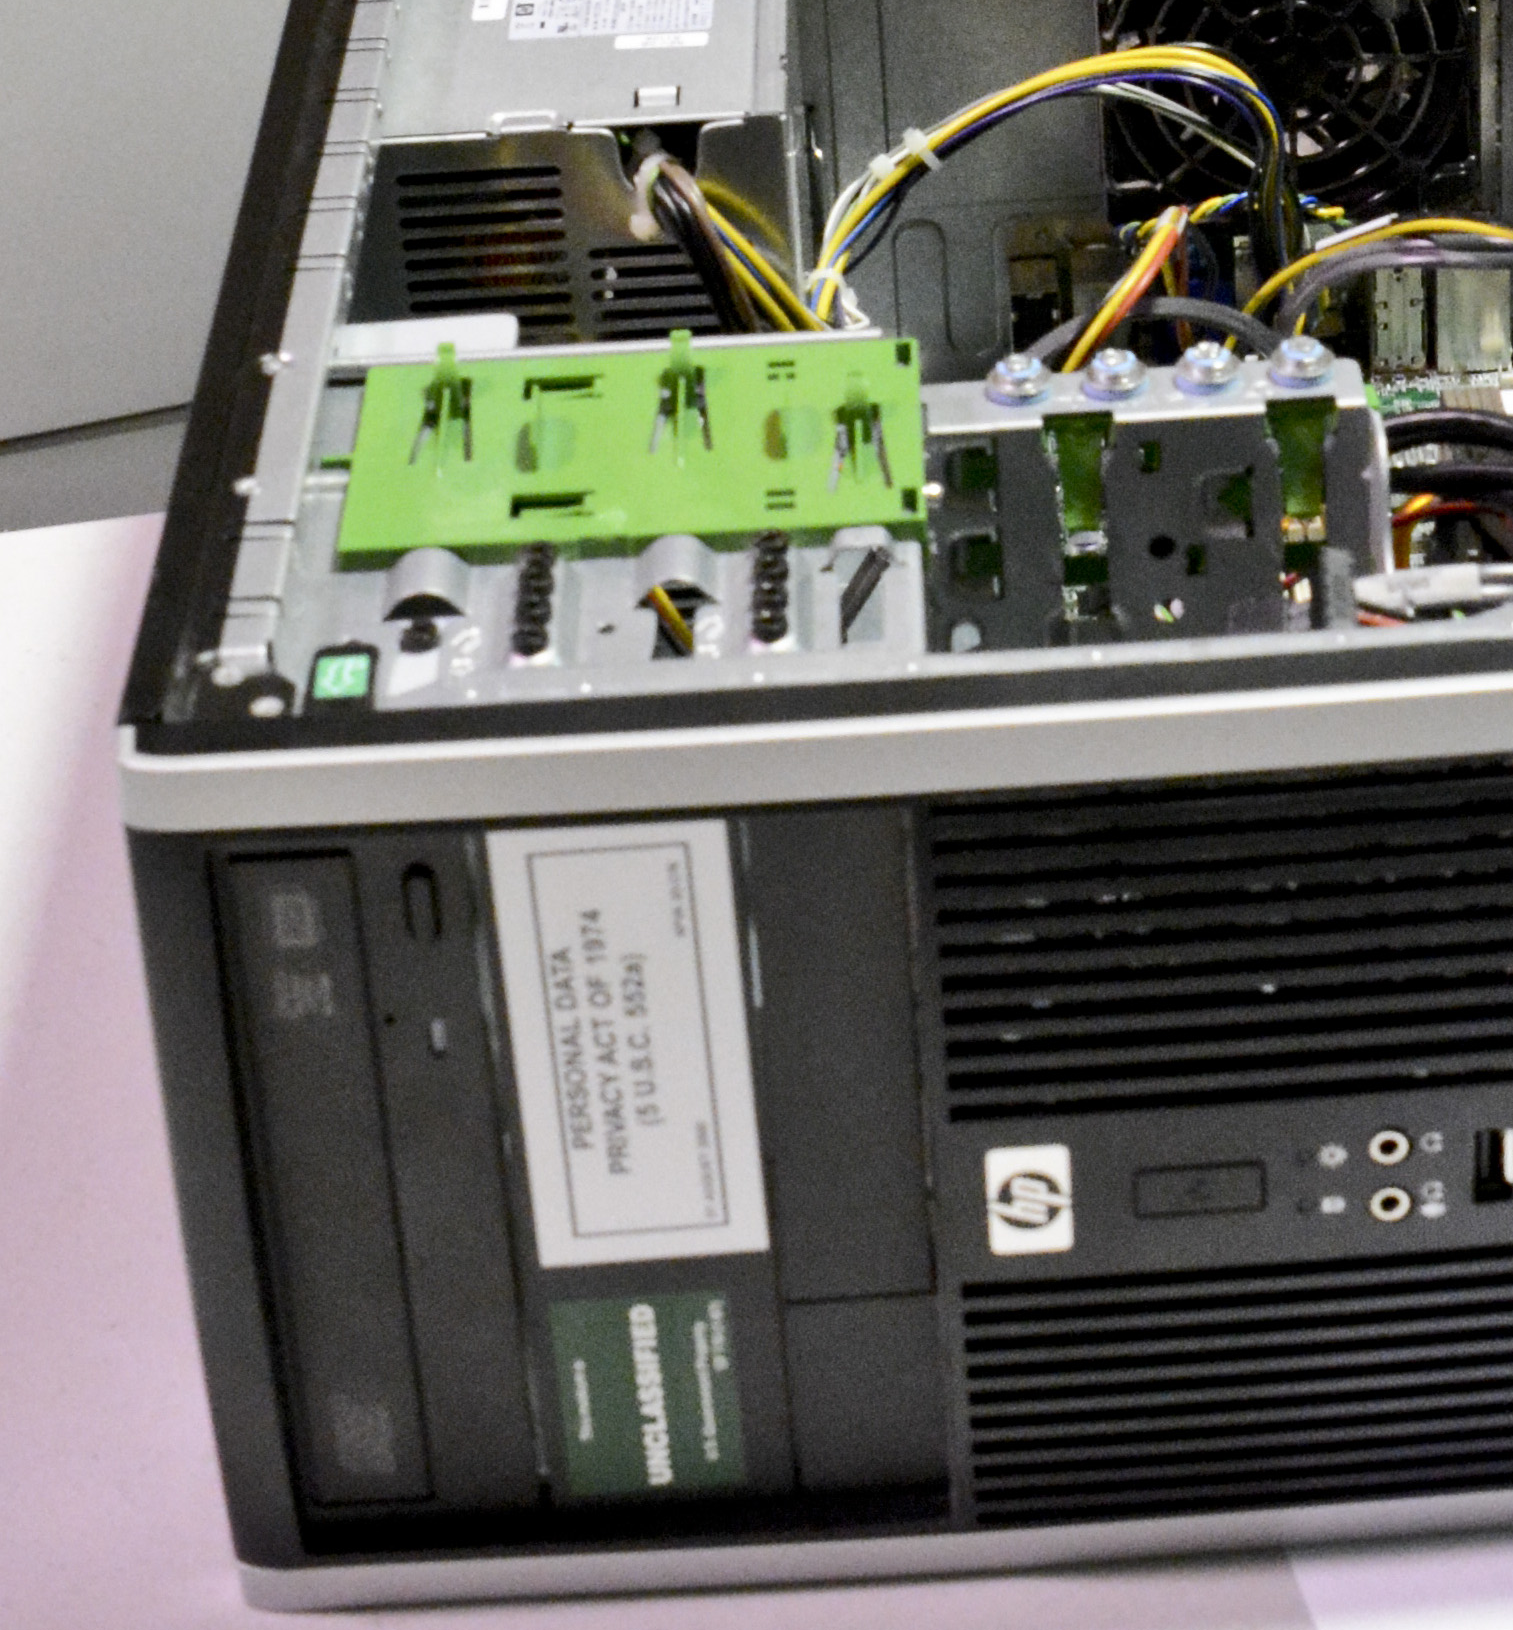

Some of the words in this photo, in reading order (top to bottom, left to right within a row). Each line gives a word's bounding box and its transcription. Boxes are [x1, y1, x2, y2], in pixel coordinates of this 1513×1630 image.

[580, 908, 606, 964] 1974
[551, 946, 577, 1011] DATA
[586, 976, 613, 1009] OF
[591, 1018, 618, 1065] ACT
[560, 1017, 593, 1150] PERSONAL
[599, 1072, 630, 1175] PRIVACY
[629, 1303, 674, 1486] UNCLASSIFIED
